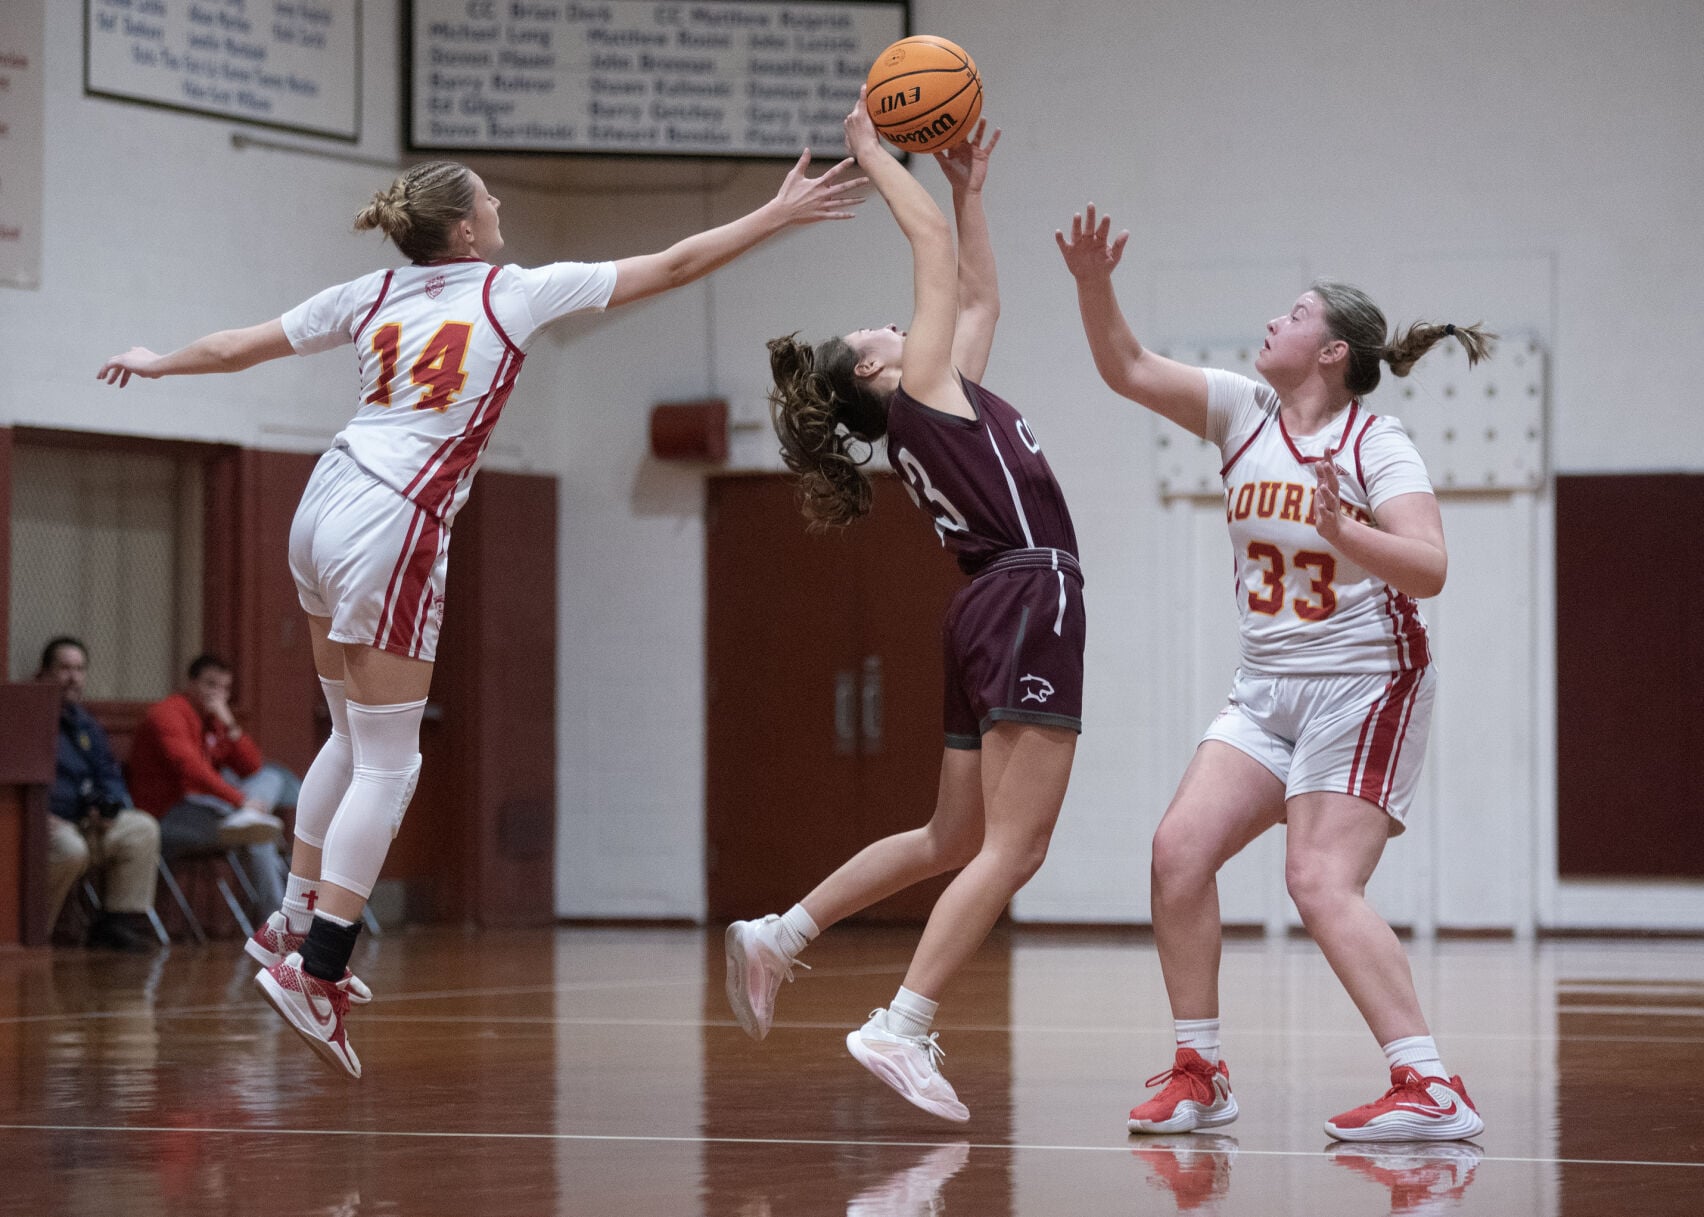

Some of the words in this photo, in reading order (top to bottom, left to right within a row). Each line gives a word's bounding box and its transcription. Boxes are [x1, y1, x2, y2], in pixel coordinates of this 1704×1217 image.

[883, 113, 957, 144] Wilson
[364, 320, 474, 413] 14
[1226, 481, 1376, 527] LOUR
[1246, 540, 1338, 622] 33
